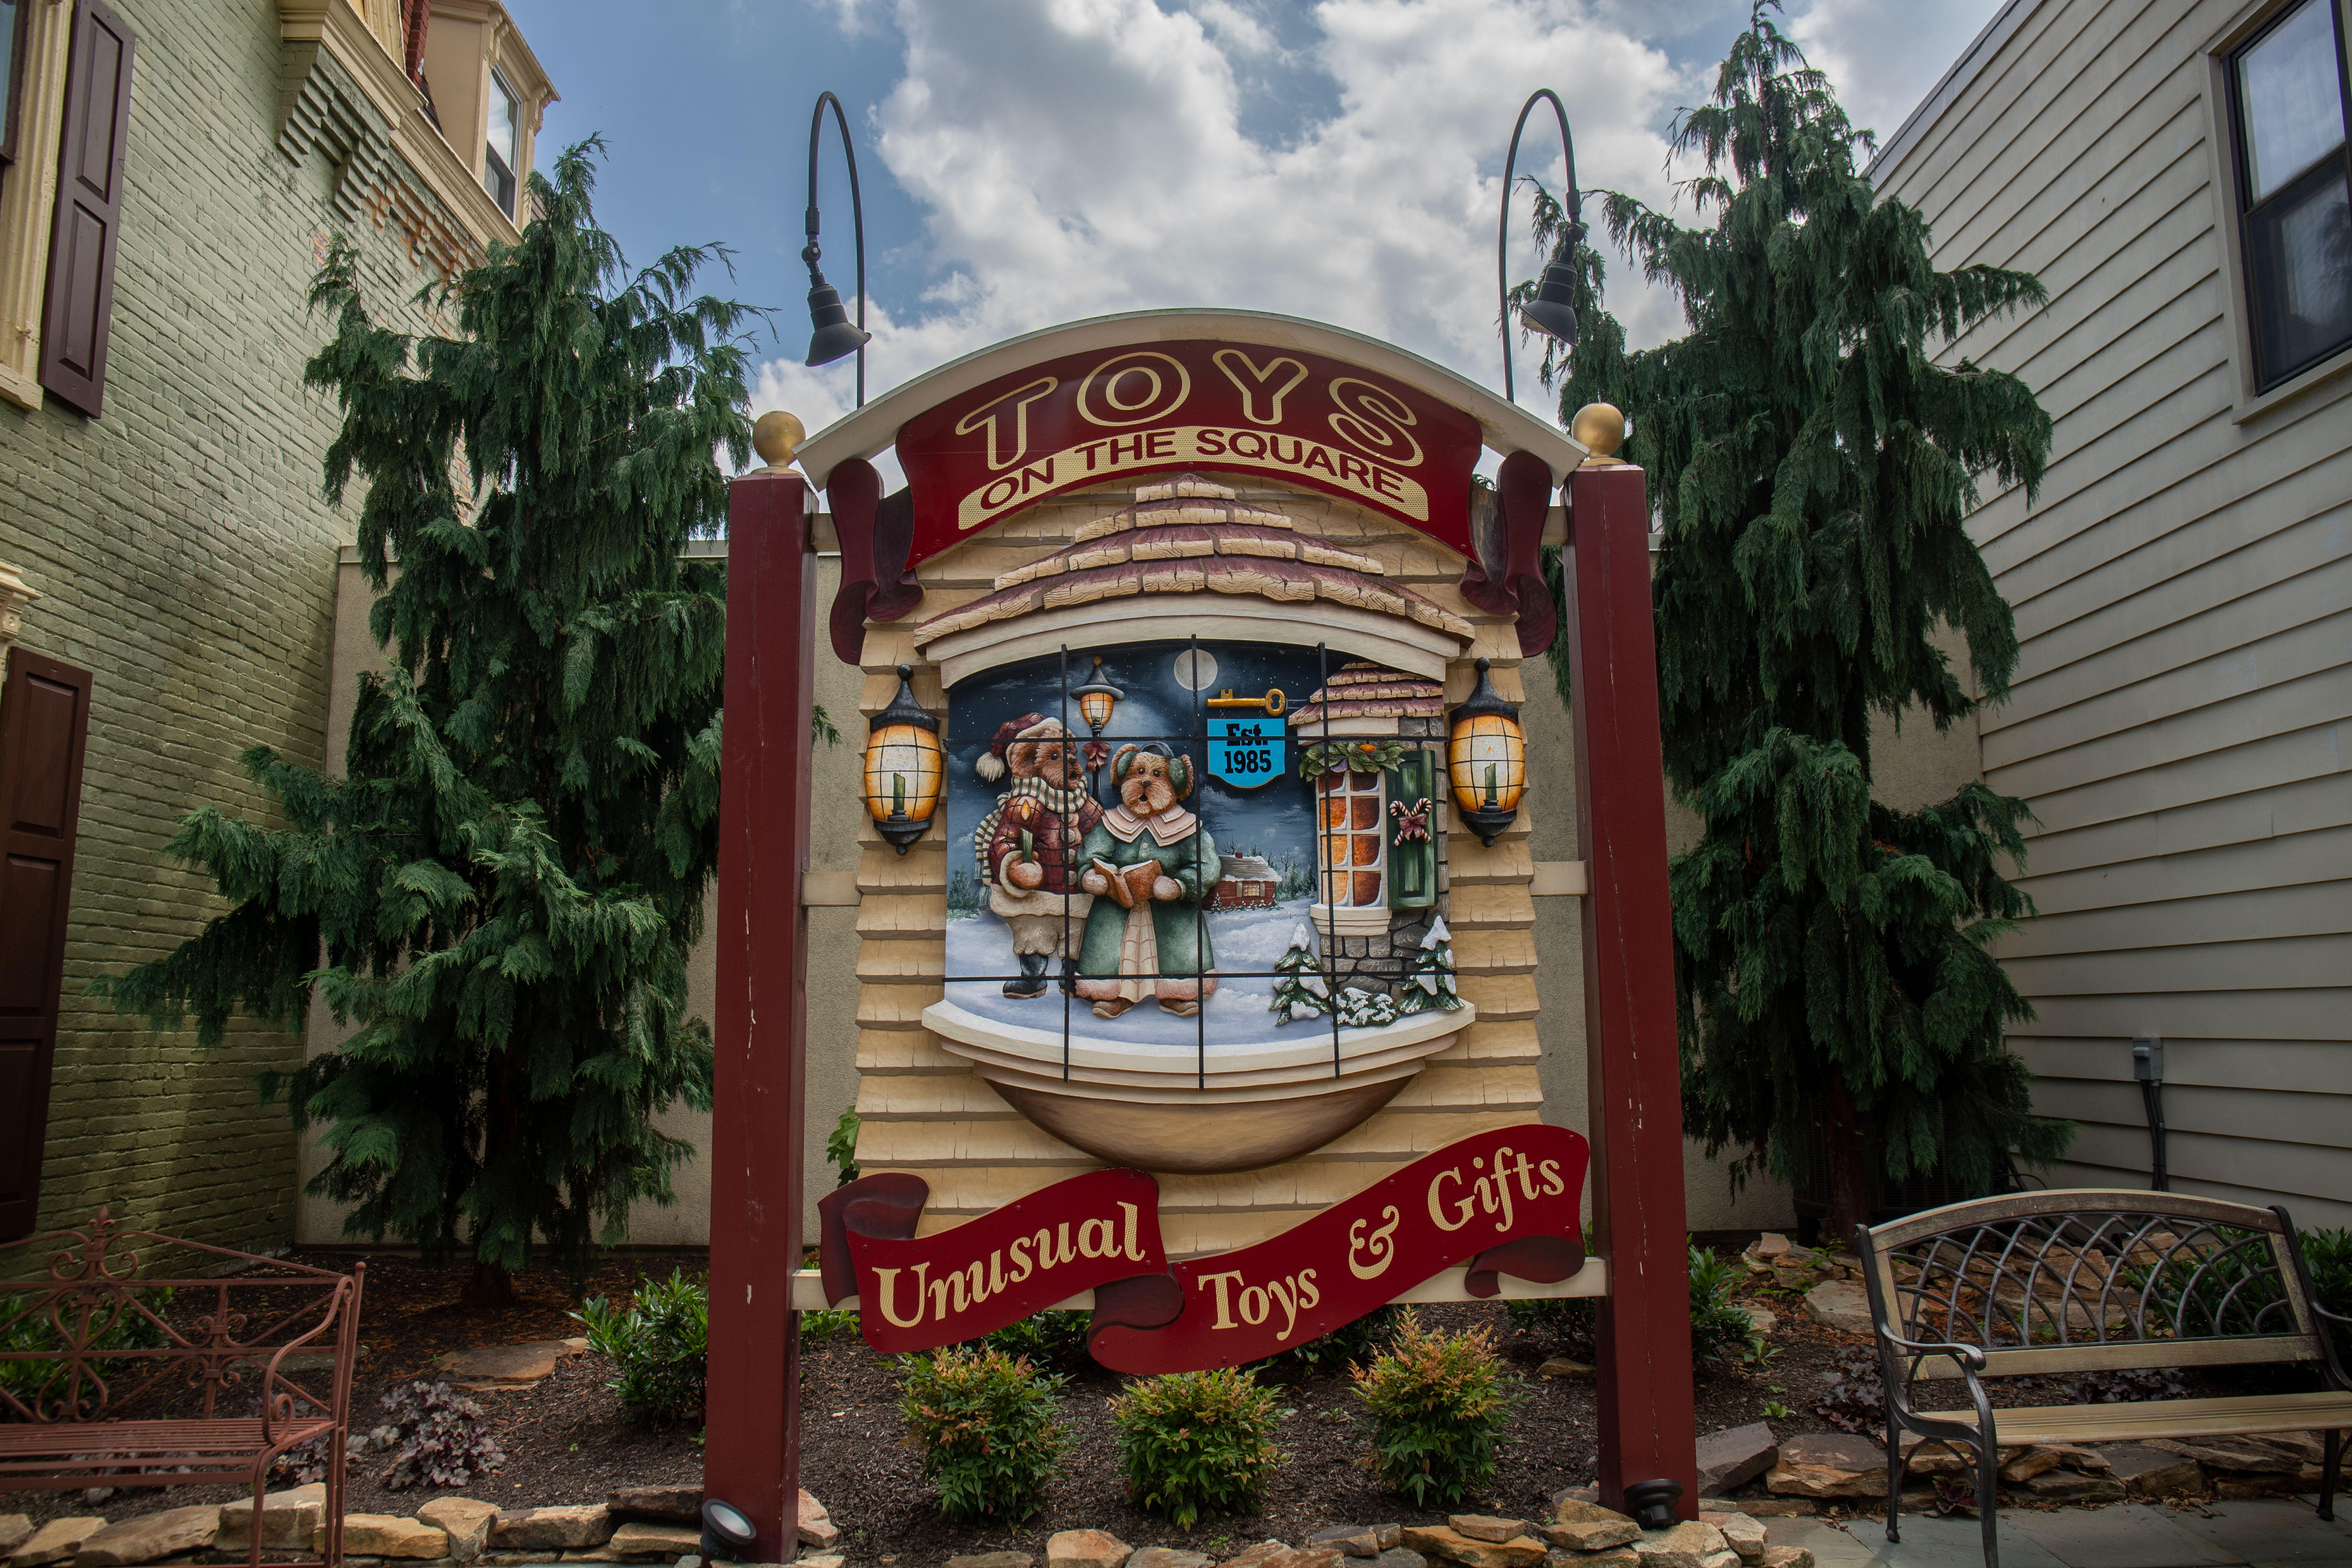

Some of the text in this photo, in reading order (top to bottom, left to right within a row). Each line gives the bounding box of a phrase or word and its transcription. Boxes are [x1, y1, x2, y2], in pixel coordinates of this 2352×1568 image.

[955, 349, 1424, 471] TOYS
[980, 429, 1405, 510] ON THE SQUARE
[1224, 749, 1272, 774] 1985
[872, 1147, 1564, 1341] Unusual Toys & Gifts
